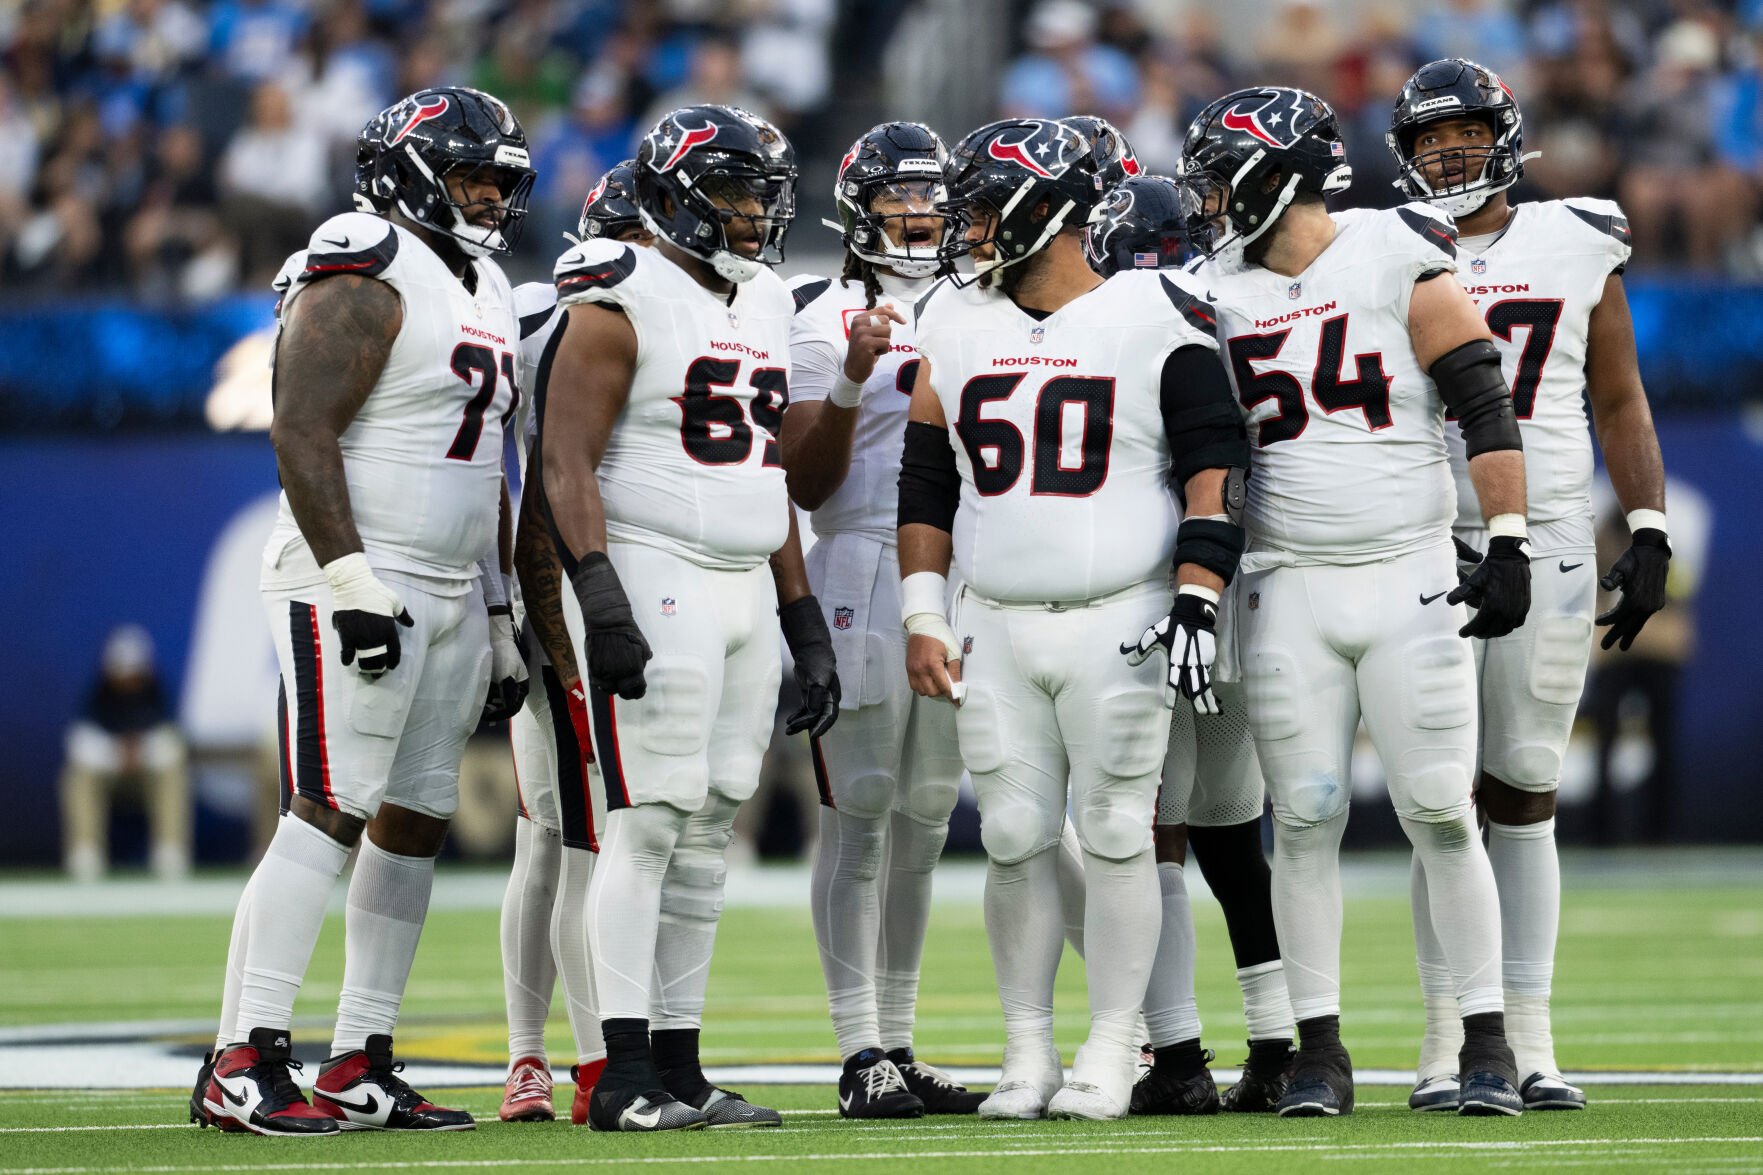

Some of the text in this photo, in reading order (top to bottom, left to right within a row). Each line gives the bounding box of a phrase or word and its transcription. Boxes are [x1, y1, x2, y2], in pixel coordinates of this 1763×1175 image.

[1464, 283, 1529, 295] USTON
[1255, 300, 1337, 329] HOUSTON
[461, 324, 506, 346] HOUSTON
[710, 340, 770, 360] HOUSTON
[992, 356, 1078, 368] HOUSTON
[1446, 298, 1566, 421] 7
[1227, 312, 1394, 448] 54
[667, 355, 790, 468] 69
[953, 371, 1116, 498] 60
